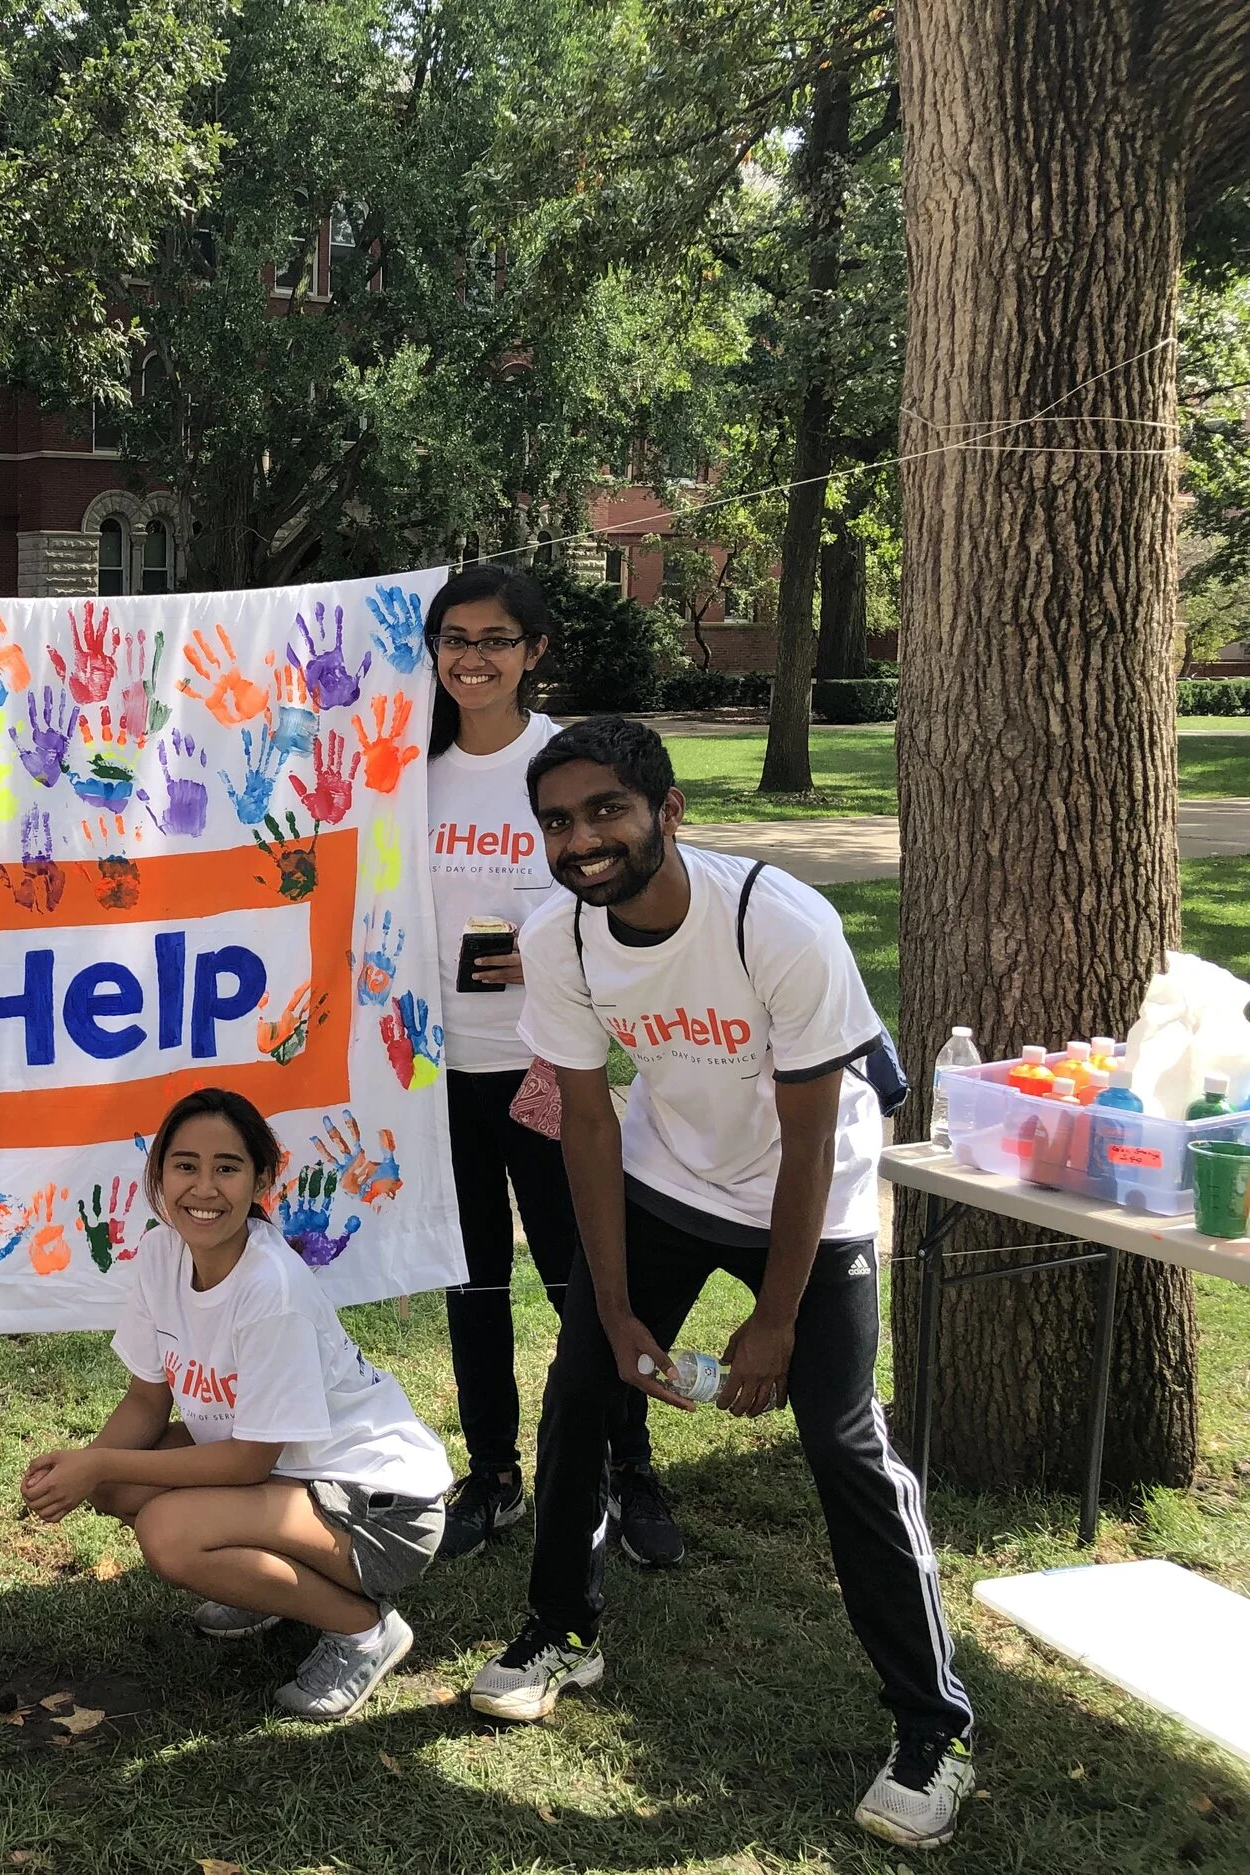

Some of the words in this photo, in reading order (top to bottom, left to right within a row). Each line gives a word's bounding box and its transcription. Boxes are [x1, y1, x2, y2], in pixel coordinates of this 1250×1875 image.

[434, 822, 535, 864] iHelp
[488, 866, 533, 875] SERVICE
[639, 1007, 751, 1055] iHelp
[671, 1049, 689, 1061] DAY
[706, 1052, 758, 1065] SERVICE
[212, 1412, 236, 1421] SERV
